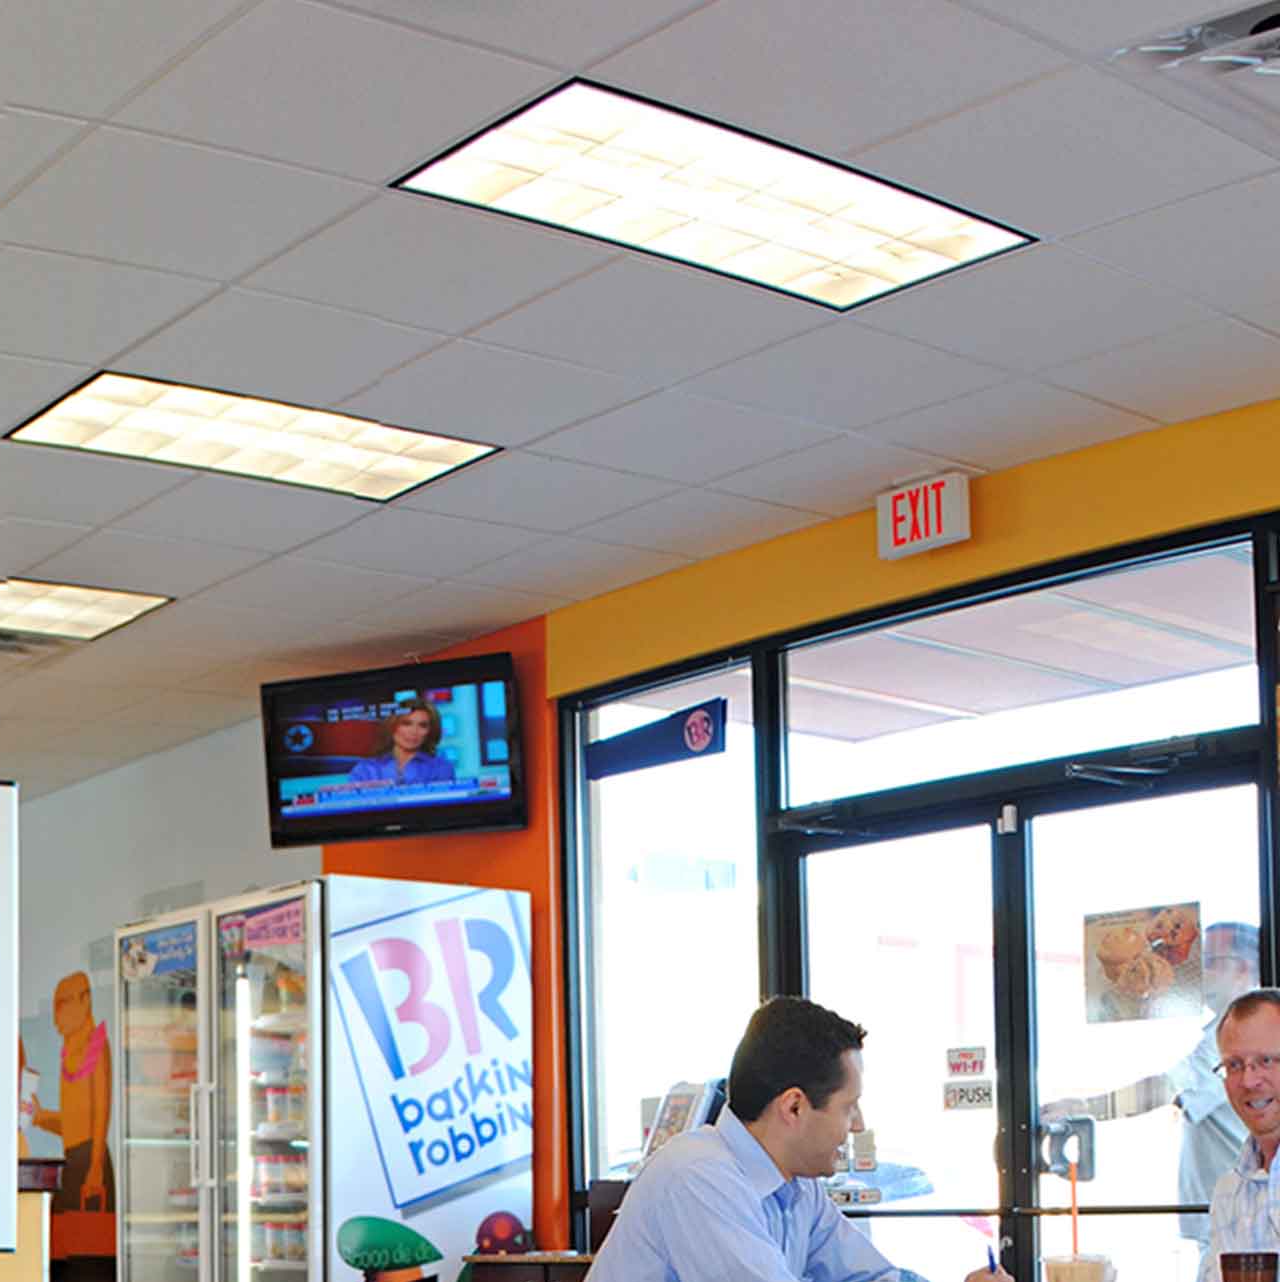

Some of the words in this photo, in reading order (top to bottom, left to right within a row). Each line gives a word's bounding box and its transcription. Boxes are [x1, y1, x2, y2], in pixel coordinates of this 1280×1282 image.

[892, 480, 945, 547] EXIT
[340, 917, 520, 1081] BR
[959, 1087, 993, 1104] PUSH
